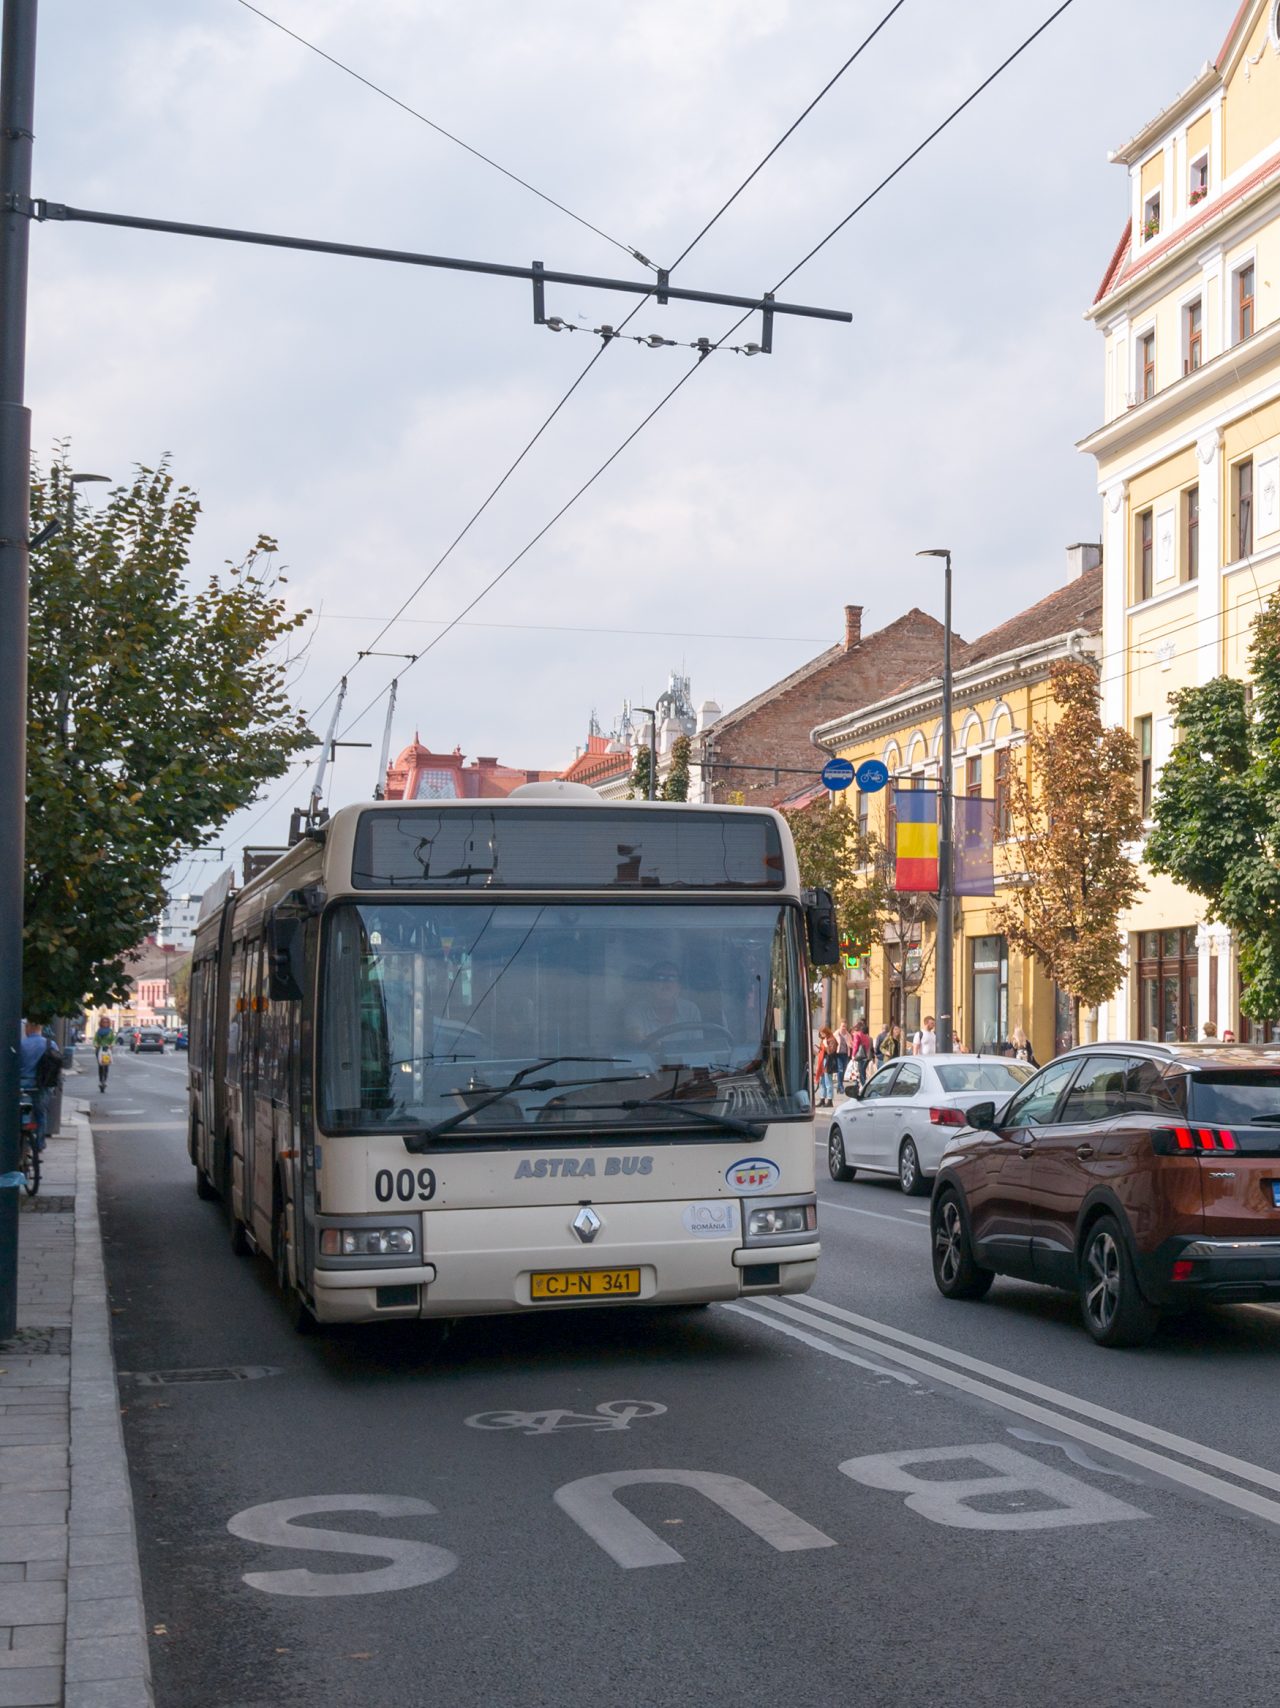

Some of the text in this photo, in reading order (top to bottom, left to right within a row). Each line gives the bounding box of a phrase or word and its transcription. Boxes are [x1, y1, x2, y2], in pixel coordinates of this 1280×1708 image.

[514, 1156, 654, 1179] ASTRA BUS
[375, 1168, 437, 1202] 009
[546, 1273, 631, 1294] CJ-N 341
